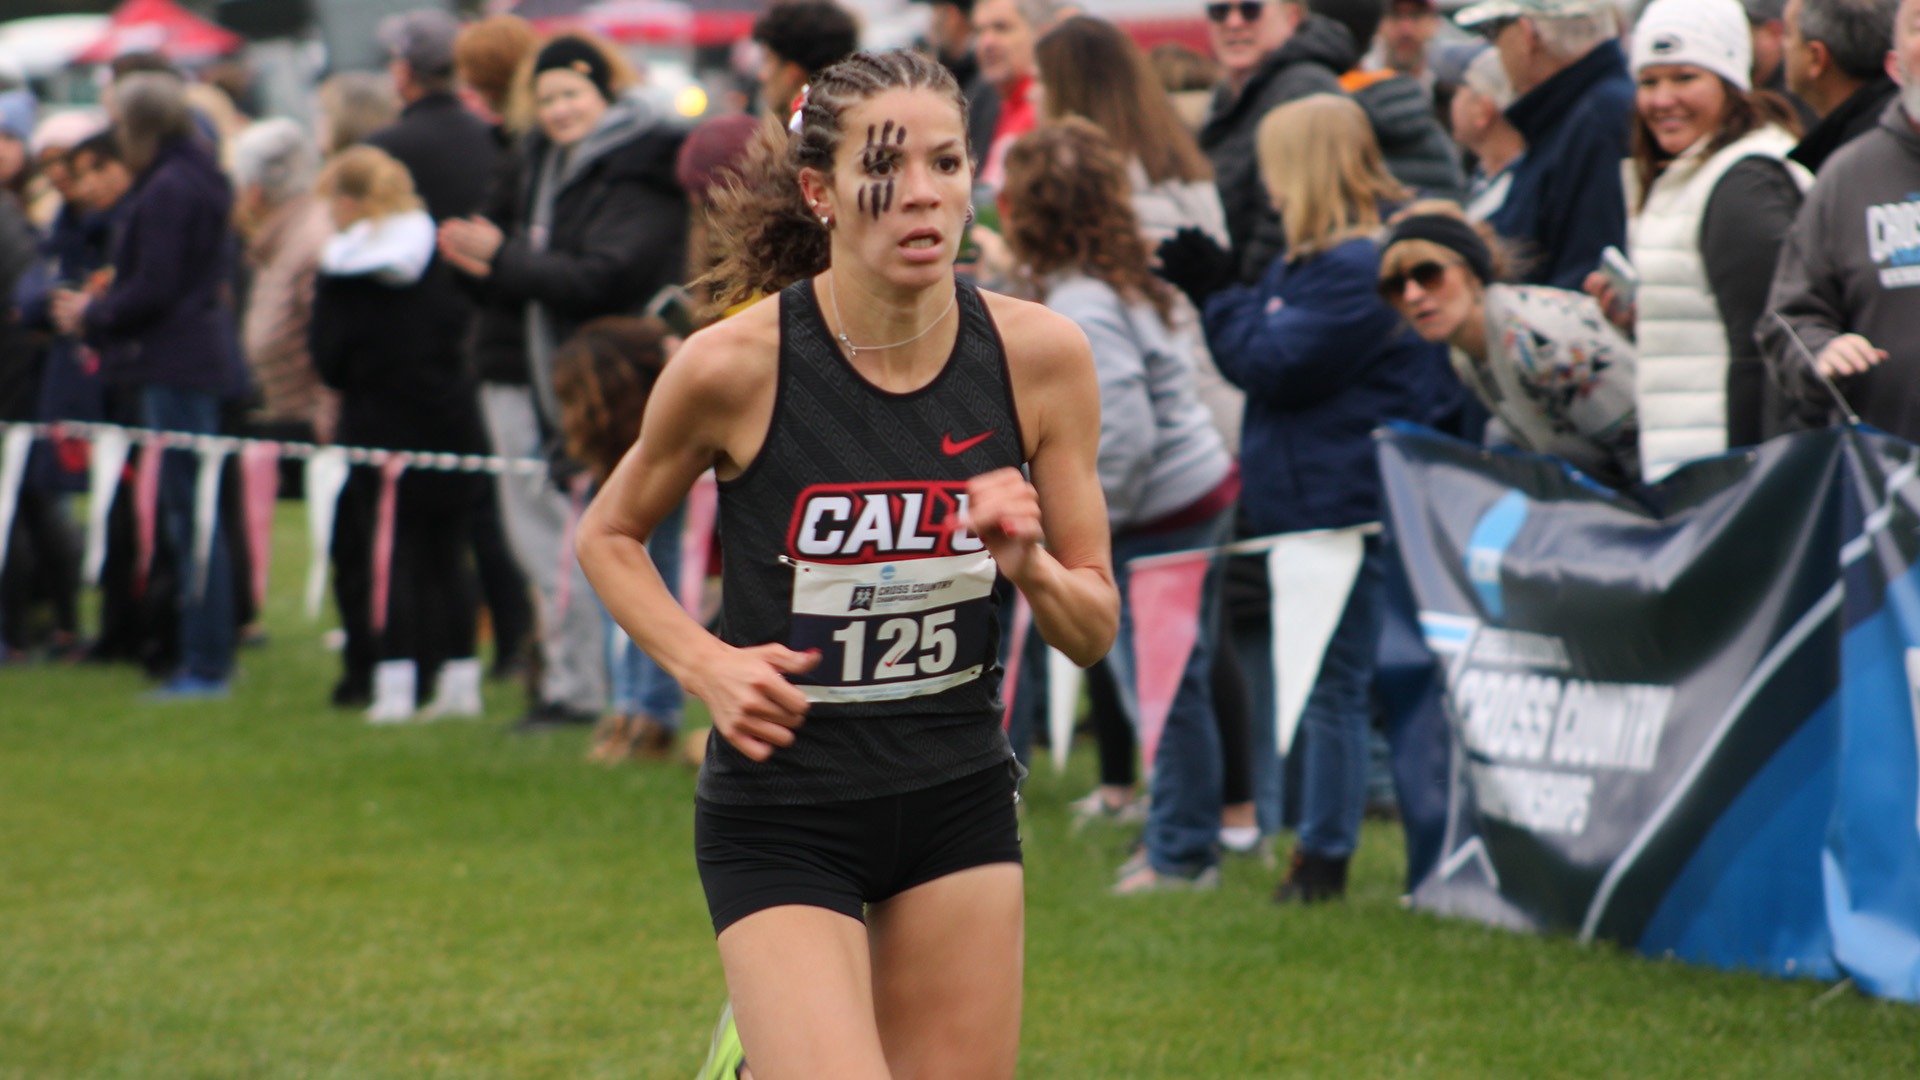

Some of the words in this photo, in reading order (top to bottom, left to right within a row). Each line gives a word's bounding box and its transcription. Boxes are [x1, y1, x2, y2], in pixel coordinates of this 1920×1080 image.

[797, 493, 936, 555] CAL
[877, 584, 910, 597] CROSS
[911, 580, 955, 594] COUNTRY
[833, 609, 957, 682] 125
[1456, 668, 1562, 763] CROSS
